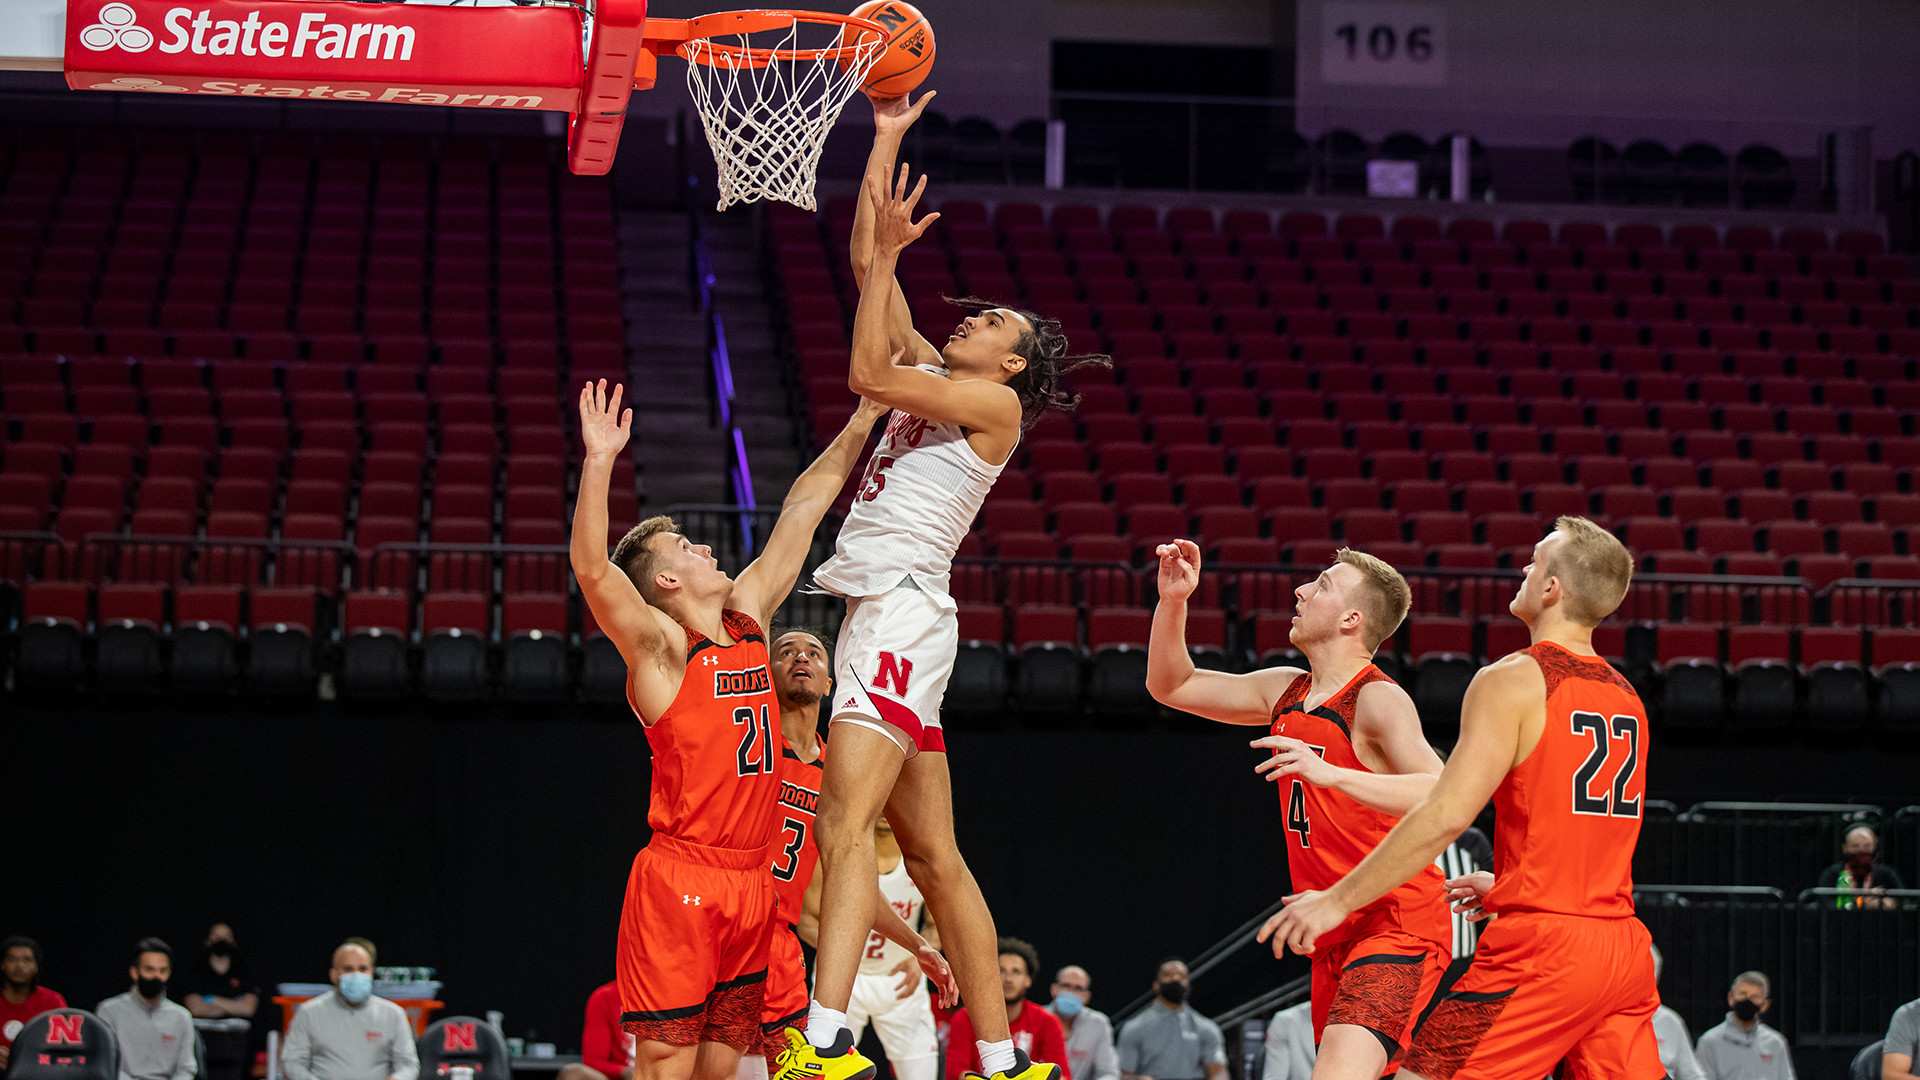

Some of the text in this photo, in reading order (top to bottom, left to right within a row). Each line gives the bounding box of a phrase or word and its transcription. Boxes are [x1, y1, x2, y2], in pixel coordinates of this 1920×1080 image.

[899, 28, 925, 51] adidas
[1335, 23, 1432, 63] 106
[198, 81, 543, 108] State Farm
[870, 651, 913, 700] N
[732, 704, 774, 777] 21
[1570, 710, 1641, 819] 22
[778, 781, 819, 816] DOAN
[1287, 779, 1310, 848] 4
[771, 816, 806, 882] 3
[46, 1014, 84, 1045] N
[443, 1022, 477, 1051] N
